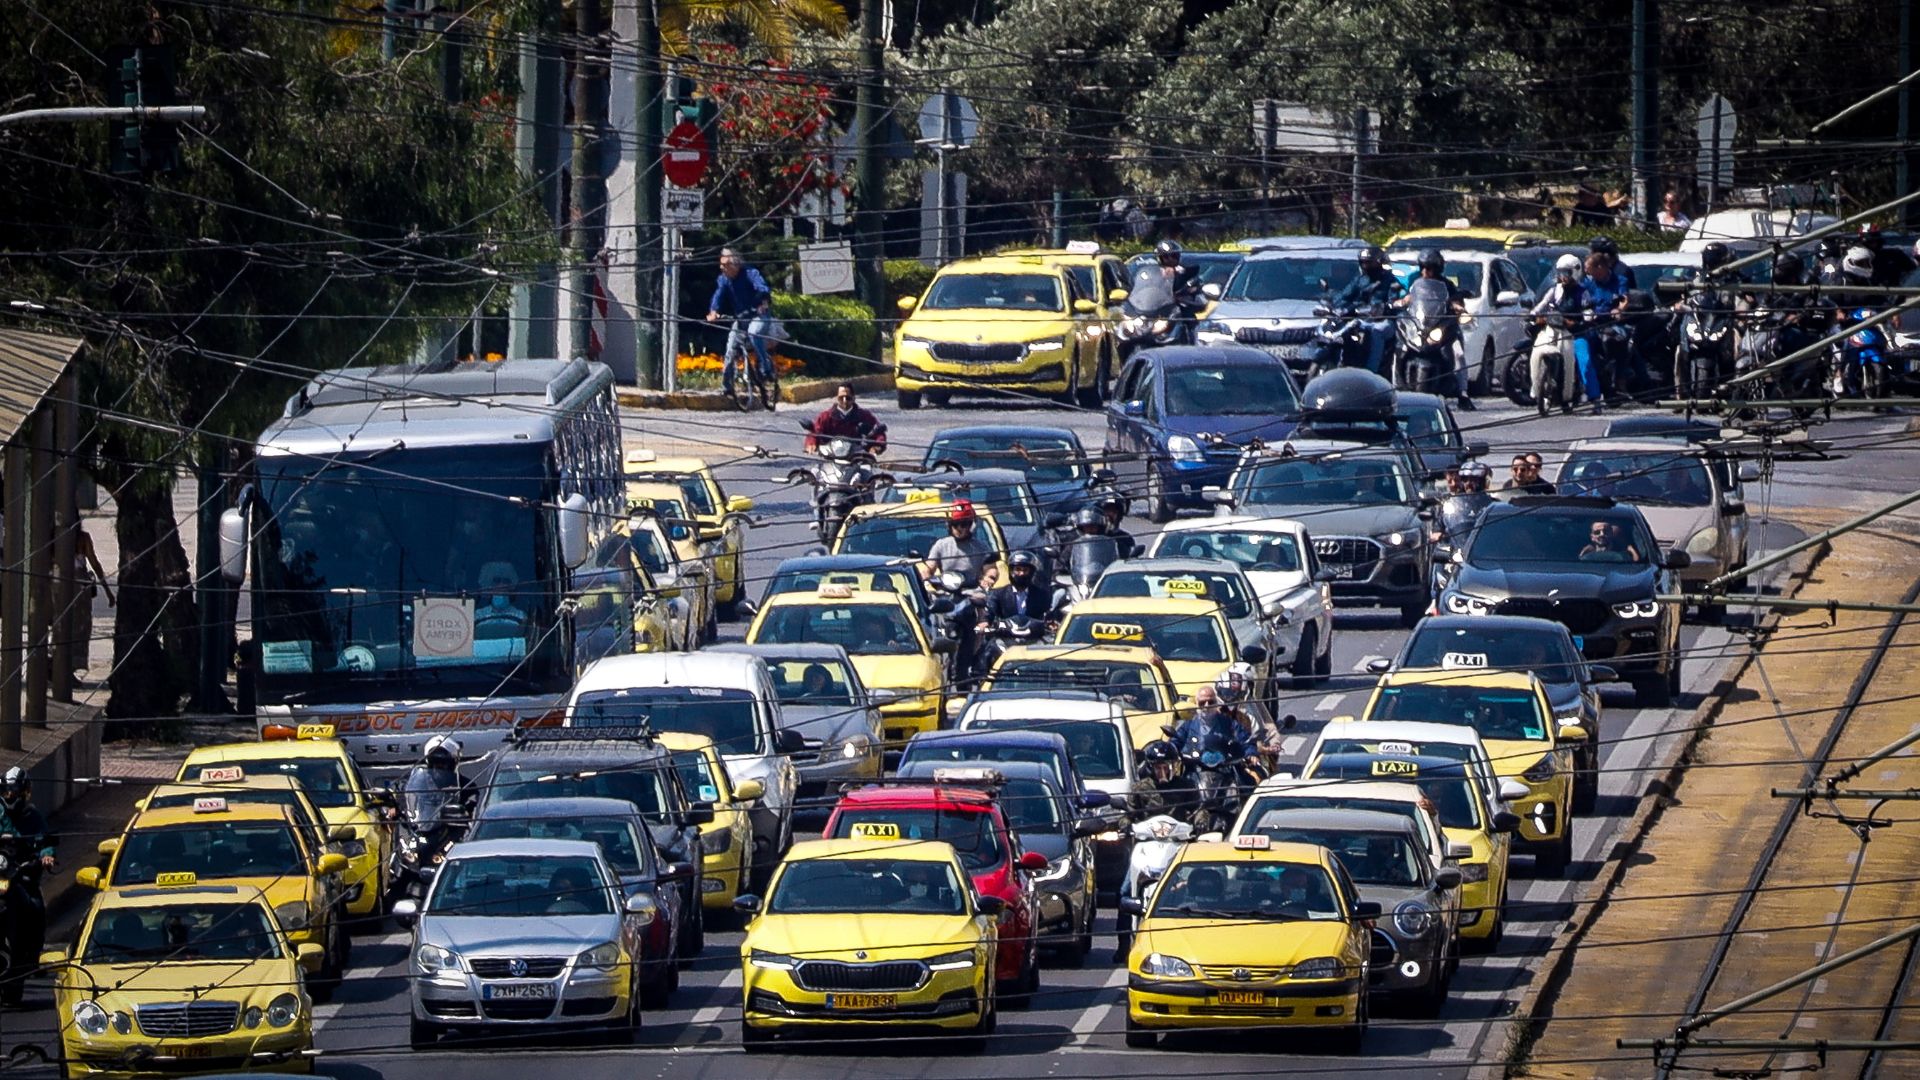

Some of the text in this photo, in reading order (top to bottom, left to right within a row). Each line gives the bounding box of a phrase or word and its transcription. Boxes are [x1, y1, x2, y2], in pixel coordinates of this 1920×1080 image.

[627, 499, 652, 509] AXI
[1168, 582, 1203, 590] TAXI
[1096, 625, 1139, 635] TAXI
[1448, 655, 1484, 666] TAXI
[413, 708, 516, 729] EVASION
[300, 727, 332, 735] TAXI
[1376, 762, 1414, 774] TAXI
[206, 768, 241, 780] TAXI
[855, 825, 896, 837] TAXI
